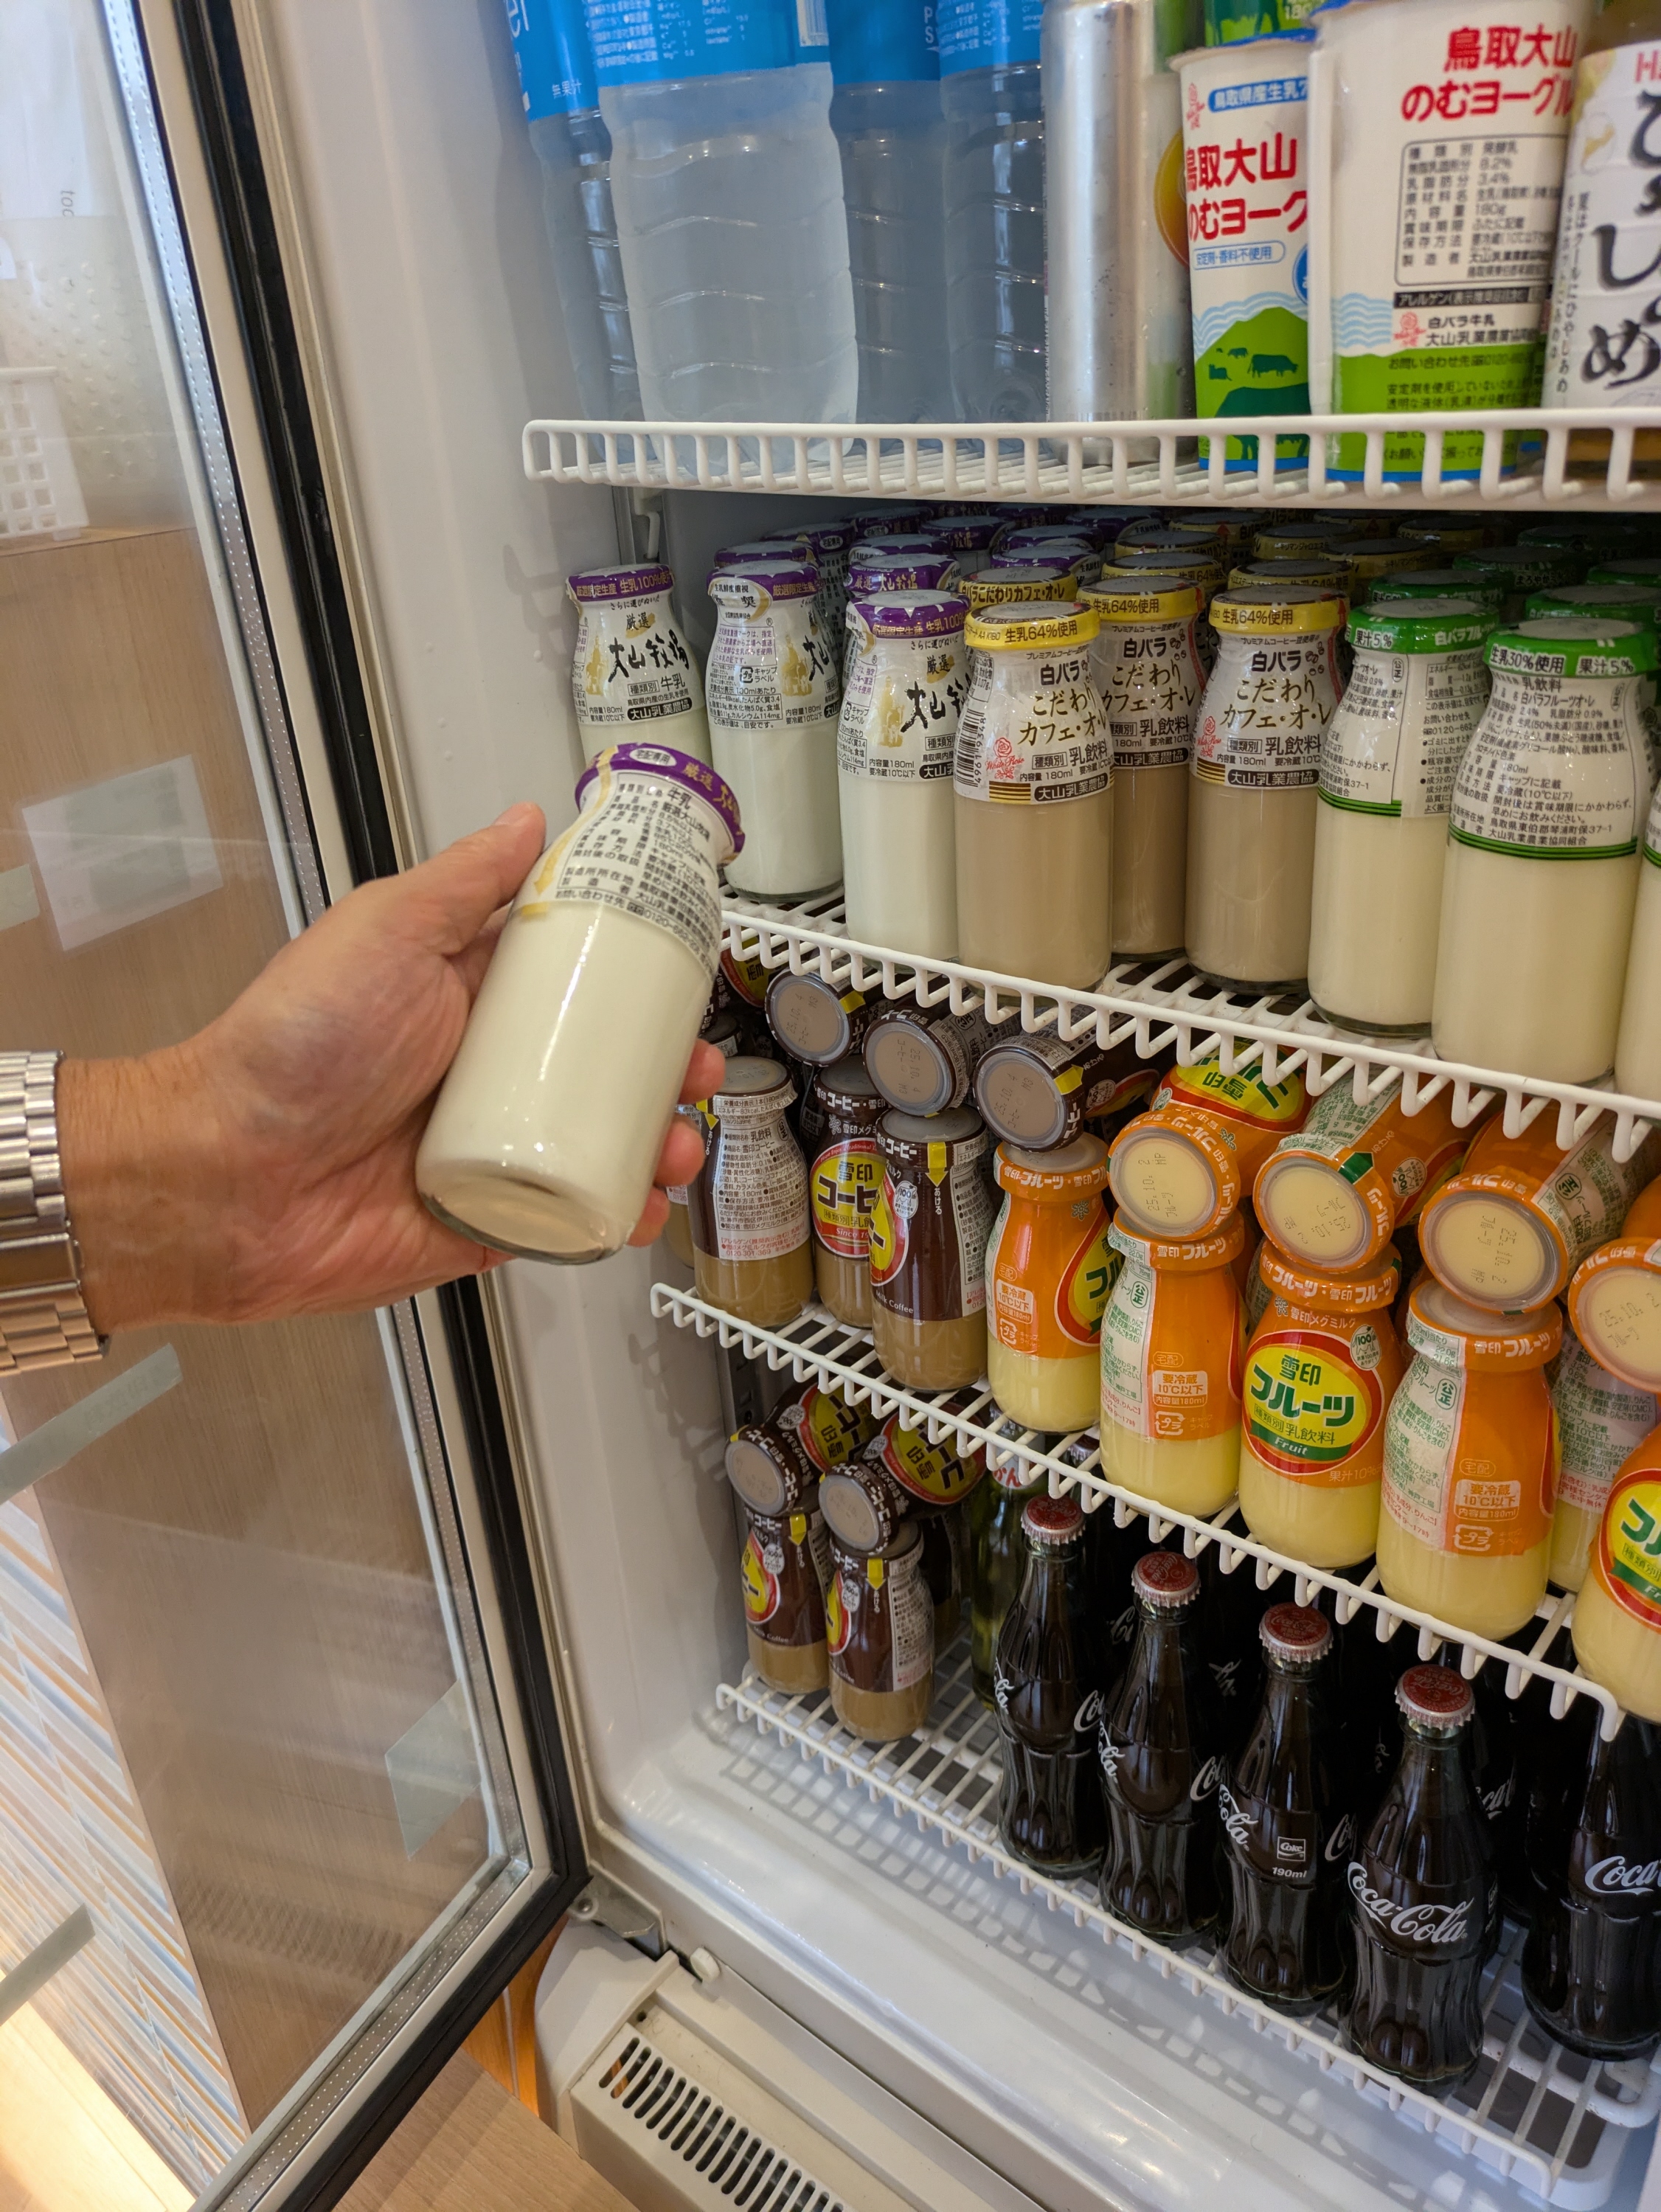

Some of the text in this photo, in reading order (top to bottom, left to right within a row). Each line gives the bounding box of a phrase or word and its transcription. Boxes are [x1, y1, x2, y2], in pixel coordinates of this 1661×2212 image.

[1443, 22, 1578, 72] 鳥取大山
[1401, 73, 1573, 122] のむヨーグル
[1186, 132, 1297, 192] 鳥取大山
[1092, 597, 1159, 614] 生乳64%使用
[626, 612, 651, 631] 厳選
[1222, 609, 1294, 625] 生乳64%使用
[1005, 621, 1078, 643] 生乳64%使用
[1355, 629, 1393, 648] 果汁5%
[1123, 637, 1167, 659] 白バラ
[926, 654, 951, 675] 厳選
[1252, 650, 1302, 672] 白バラ
[1490, 645, 1634, 674] 生乳30%使用 果汁5%
[754, 666, 777, 675] キャップ
[755, 675, 774, 683] ラベル
[1041, 659, 1080, 685] 白バラ
[1112, 659, 1181, 688] こだわり
[630, 673, 686, 694] 種類別 牛乳
[1236, 674, 1315, 703] こだわり
[1522, 676, 1561, 693] 乳飲料
[1033, 682, 1097, 717] こだわり
[589, 706, 623, 715] 内容量180ml
[631, 700, 690, 720] 大山乳業農協
[786, 706, 822, 715] 内容量180ml
[1219, 703, 1333, 729] カフェ・オ・レ
[1424, 712, 1471, 725] お問い合わせ先
[1584, 710, 1603, 718] 0.9%
[1017, 709, 1106, 746] カフェ・オ・レ
[1140, 715, 1190, 738] 乳飲料
[1034, 738, 1108, 768] 種類別 乳飲料
[1115, 739, 1142, 748] 180ml
[1229, 734, 1321, 756] 種類別 乳飲料
[870, 758, 915, 769] 内容量180ml
[1217, 754, 1266, 766] 内容量 180ml
[1019, 769, 1073, 781] 内容量 180ml
[1230, 771, 1314, 785] 大山乳業農協
[1038, 775, 1106, 800] 大山乳業農協
[667, 788, 693, 810] 牛乳
[827, 1094, 860, 1111] コーヒー
[751, 1127, 772, 1143] 乳飲料
[742, 1141, 775, 1154] 雪印コーヒー
[885, 1137, 918, 1159] コーヒー
[838, 1161, 873, 1182] 雪印
[1004, 1166, 1092, 1190] 雪印 フルーツ 雪印
[933, 1187, 943, 1216] あける
[836, 1227, 858, 1238] Since
[1157, 1238, 1227, 1260] 雪印 フルーツ
[999, 1265, 1014, 1278] 宅配
[1001, 1283, 1027, 1300] 要冷蔵
[1133, 1283, 1147, 1305] 公正
[1272, 1265, 1393, 1304] フルーツ 雪印 フルーツ
[888, 1300, 914, 1314] Coffee
[1290, 1306, 1356, 1330] 雪印メグミルク
[1357, 1335, 1372, 1345] 100
[1474, 1332, 1550, 1358] 雪印 フルーツ
[1156, 1353, 1179, 1365] 宅配
[1162, 1373, 1198, 1384] 要冷蔵
[1280, 1353, 1322, 1387] 雪印
[1157, 1384, 1204, 1395] 10℃以下
[1249, 1363, 1355, 1428] フルーツ
[1440, 1379, 1454, 1407] 公正
[1155, 1395, 1205, 1406] 内容量180ml
[1161, 1418, 1182, 1429] プラ
[1255, 1405, 1335, 1445] 種類別 乳飲料
[1274, 1436, 1309, 1457] Fruit
[905, 1446, 935, 1480] 雪印
[1463, 1460, 1491, 1475] 宅配
[1470, 1483, 1511, 1497] 要冷蔵
[1463, 1494, 1516, 1508] 10℃以下
[1458, 1508, 1517, 1519] 内容量180ml
[1280, 1841, 1303, 1857] Coke
[1272, 1867, 1307, 1879] 190ml
[1347, 1861, 1474, 1944] Coca-Cola
